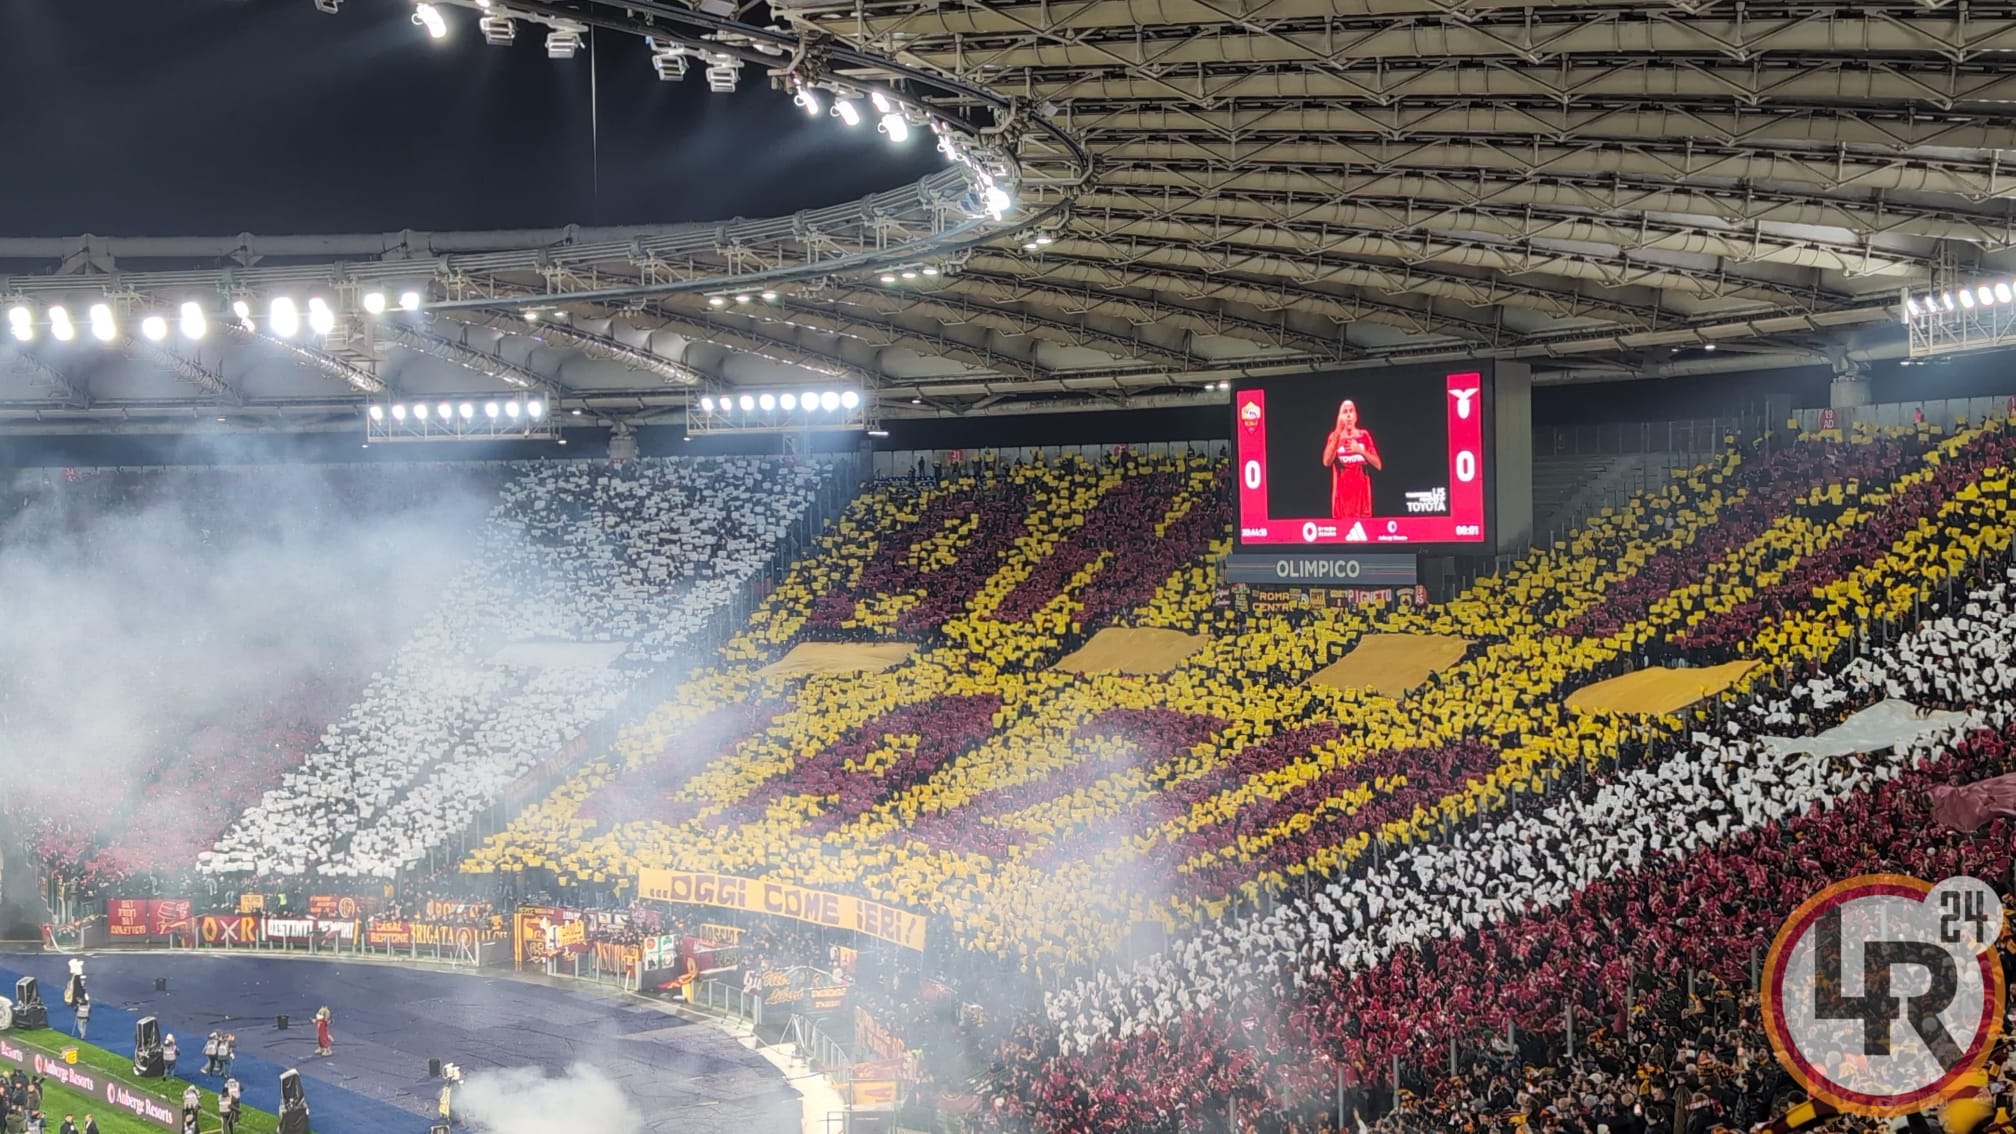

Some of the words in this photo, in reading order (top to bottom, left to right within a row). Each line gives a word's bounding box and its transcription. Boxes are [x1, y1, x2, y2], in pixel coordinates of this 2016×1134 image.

[1245, 460, 1261, 489] 0
[1456, 450, 1475, 482] 0
[1406, 501, 1447, 512] TOYOTA
[1276, 560, 1360, 578] OLIMPICO
[1260, 591, 1290, 601] ROMA
[764, 881, 841, 924] COME
[145, 1099, 173, 1125] Resorts
